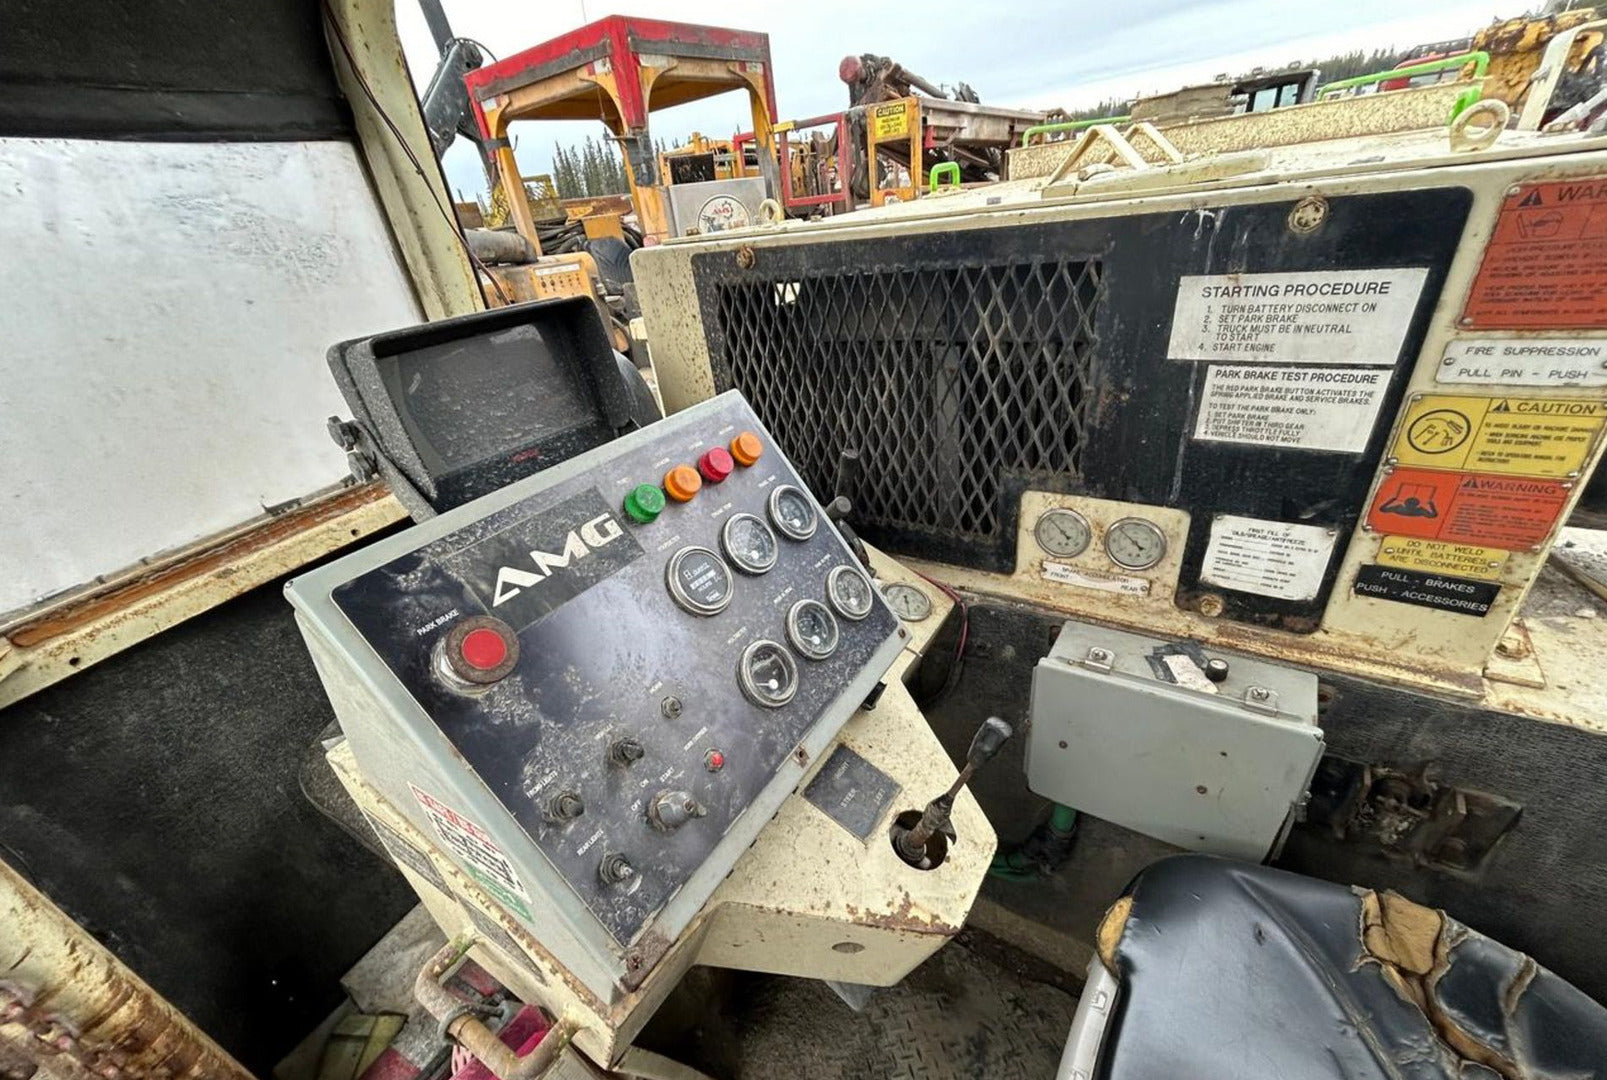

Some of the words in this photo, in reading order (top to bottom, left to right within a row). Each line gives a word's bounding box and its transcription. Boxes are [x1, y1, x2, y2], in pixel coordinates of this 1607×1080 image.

[1201, 284, 1280, 298] STARTING
[1283, 281, 1392, 296] PROCEDURE
[1221, 305, 1246, 313] TURN
[1247, 304, 1294, 313] BATTERY
[1295, 303, 1359, 313] DISCONNECT
[1361, 302, 1377, 313] ON
[1219, 314, 1238, 323] SET
[1238, 314, 1264, 323] PARK
[1265, 314, 1298, 323] BRAKE
[1217, 325, 1248, 333] TRUCK
[1249, 325, 1276, 333] MUST
[1278, 325, 1291, 333] BE
[1293, 325, 1304, 333] IN
[1304, 324, 1352, 334] NEUTRAL
[1216, 333, 1228, 341] TO
[1229, 333, 1260, 341] START
[1212, 343, 1243, 352] START
[1244, 343, 1276, 352] ENGINE
[1465, 346, 1495, 356] FIRE
[1503, 346, 1601, 357] SUPPRESSION
[1215, 369, 1241, 379] PARK
[1243, 370, 1278, 380] BRAKE
[1281, 371, 1308, 381] TEST
[1310, 373, 1380, 384] PROCEDURE
[1458, 368, 1491, 378] PULL
[1500, 368, 1523, 378] PIN
[1548, 369, 1588, 379] PUSH
[1234, 392, 1264, 400] APPLIED
[1305, 396, 1337, 404] SERVICE
[1284, 387, 1314, 395] BUTTON
[1315, 389, 1358, 397] ACTIVATES
[1359, 390, 1375, 398] THE
[1270, 406, 1293, 414] BRAKE
[1517, 402, 1597, 415] CAUTION
[1480, 480, 1557, 495] WARNING
[1426, 542, 1447, 551] NOT
[1454, 546, 1484, 555] WELD
[493, 512, 624, 608] AMG
[1396, 547, 1423, 557] UNTIL
[1430, 551, 1487, 565] BATTERIES
[1390, 554, 1408, 563] ARE
[1414, 558, 1488, 573] DISCONNECTED
[1381, 571, 1409, 583] PULL
[1425, 579, 1476, 594] BRAKES
[1357, 582, 1388, 593] PUSH
[1401, 590, 1488, 612] ACCESSORIES
[417, 621, 438, 636] PARK
[435, 609, 459, 626] BRAKE
